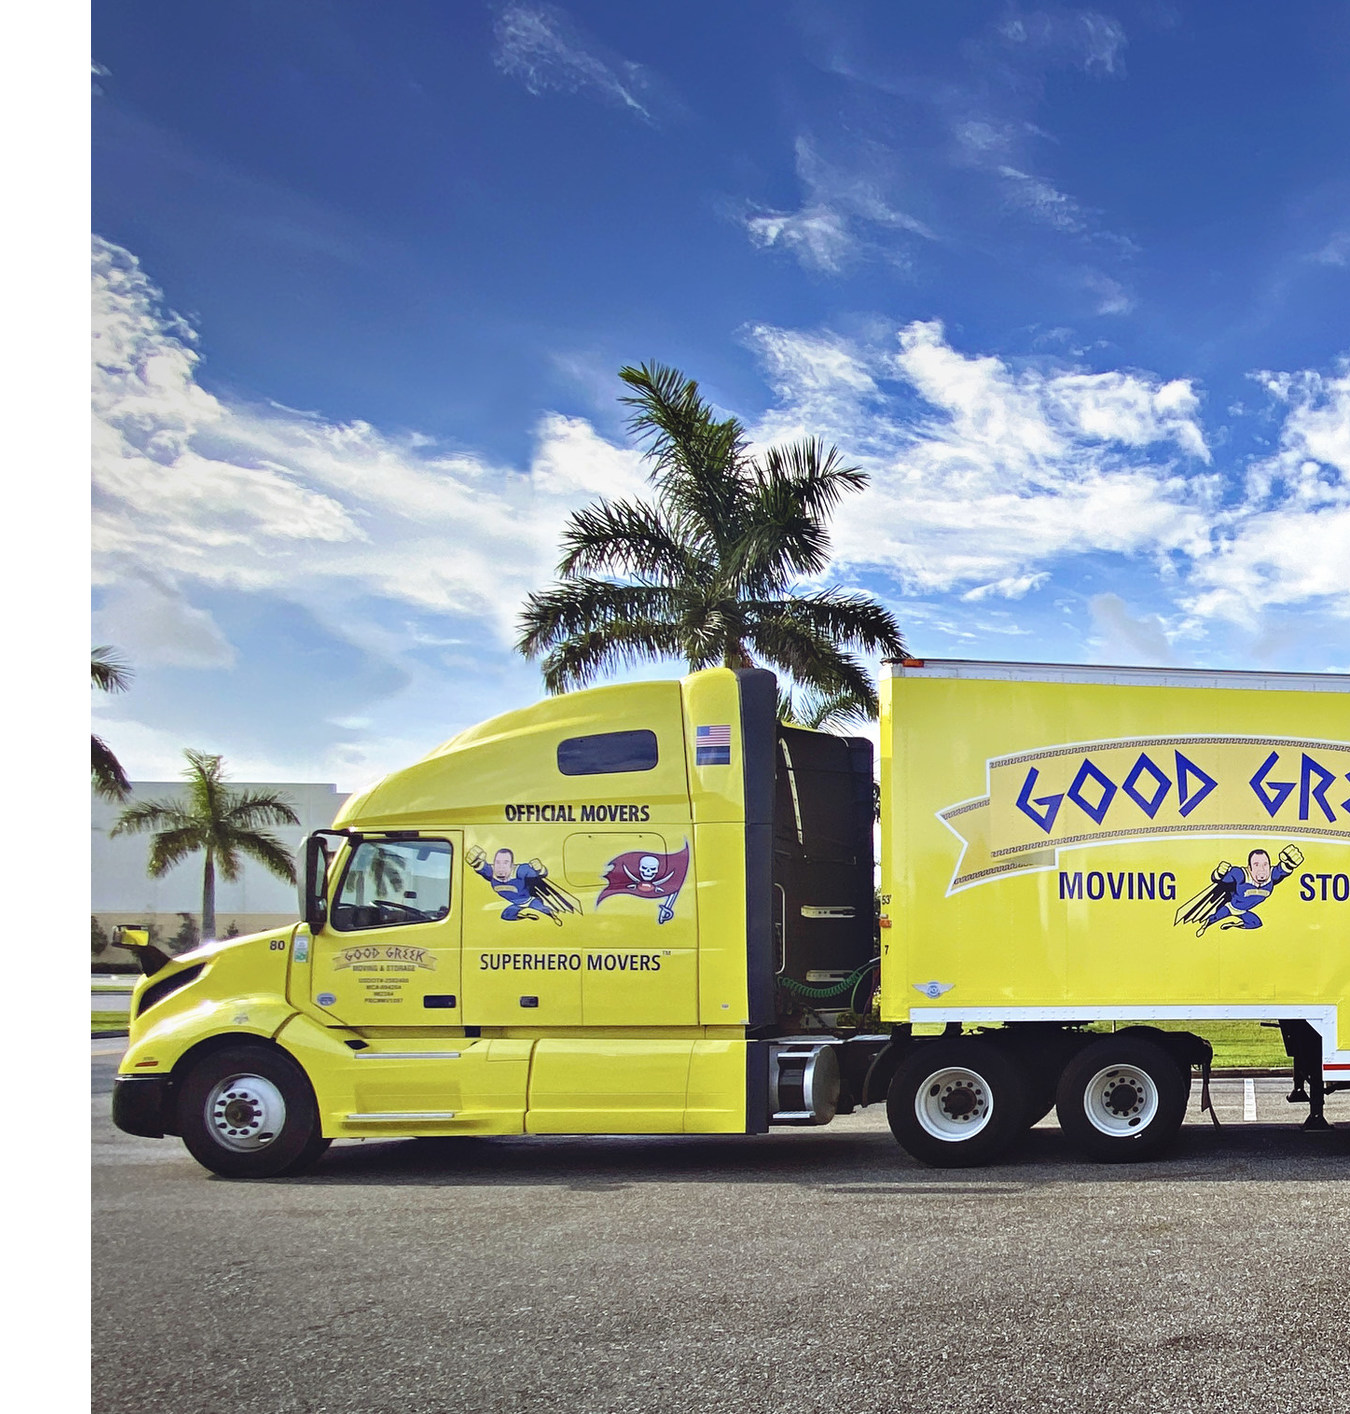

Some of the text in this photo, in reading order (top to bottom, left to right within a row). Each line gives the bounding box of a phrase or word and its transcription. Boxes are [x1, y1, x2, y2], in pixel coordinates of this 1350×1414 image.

[1015, 748, 1219, 835] GOOD
[505, 804, 650, 822] OFFICIAL MOVERS
[1059, 871, 1177, 902] MOVING
[269, 940, 286, 951] 80
[344, 946, 426, 963] GOOD GREEK
[480, 953, 581, 971] SUPERHERO
[587, 954, 661, 971] MOVERS
